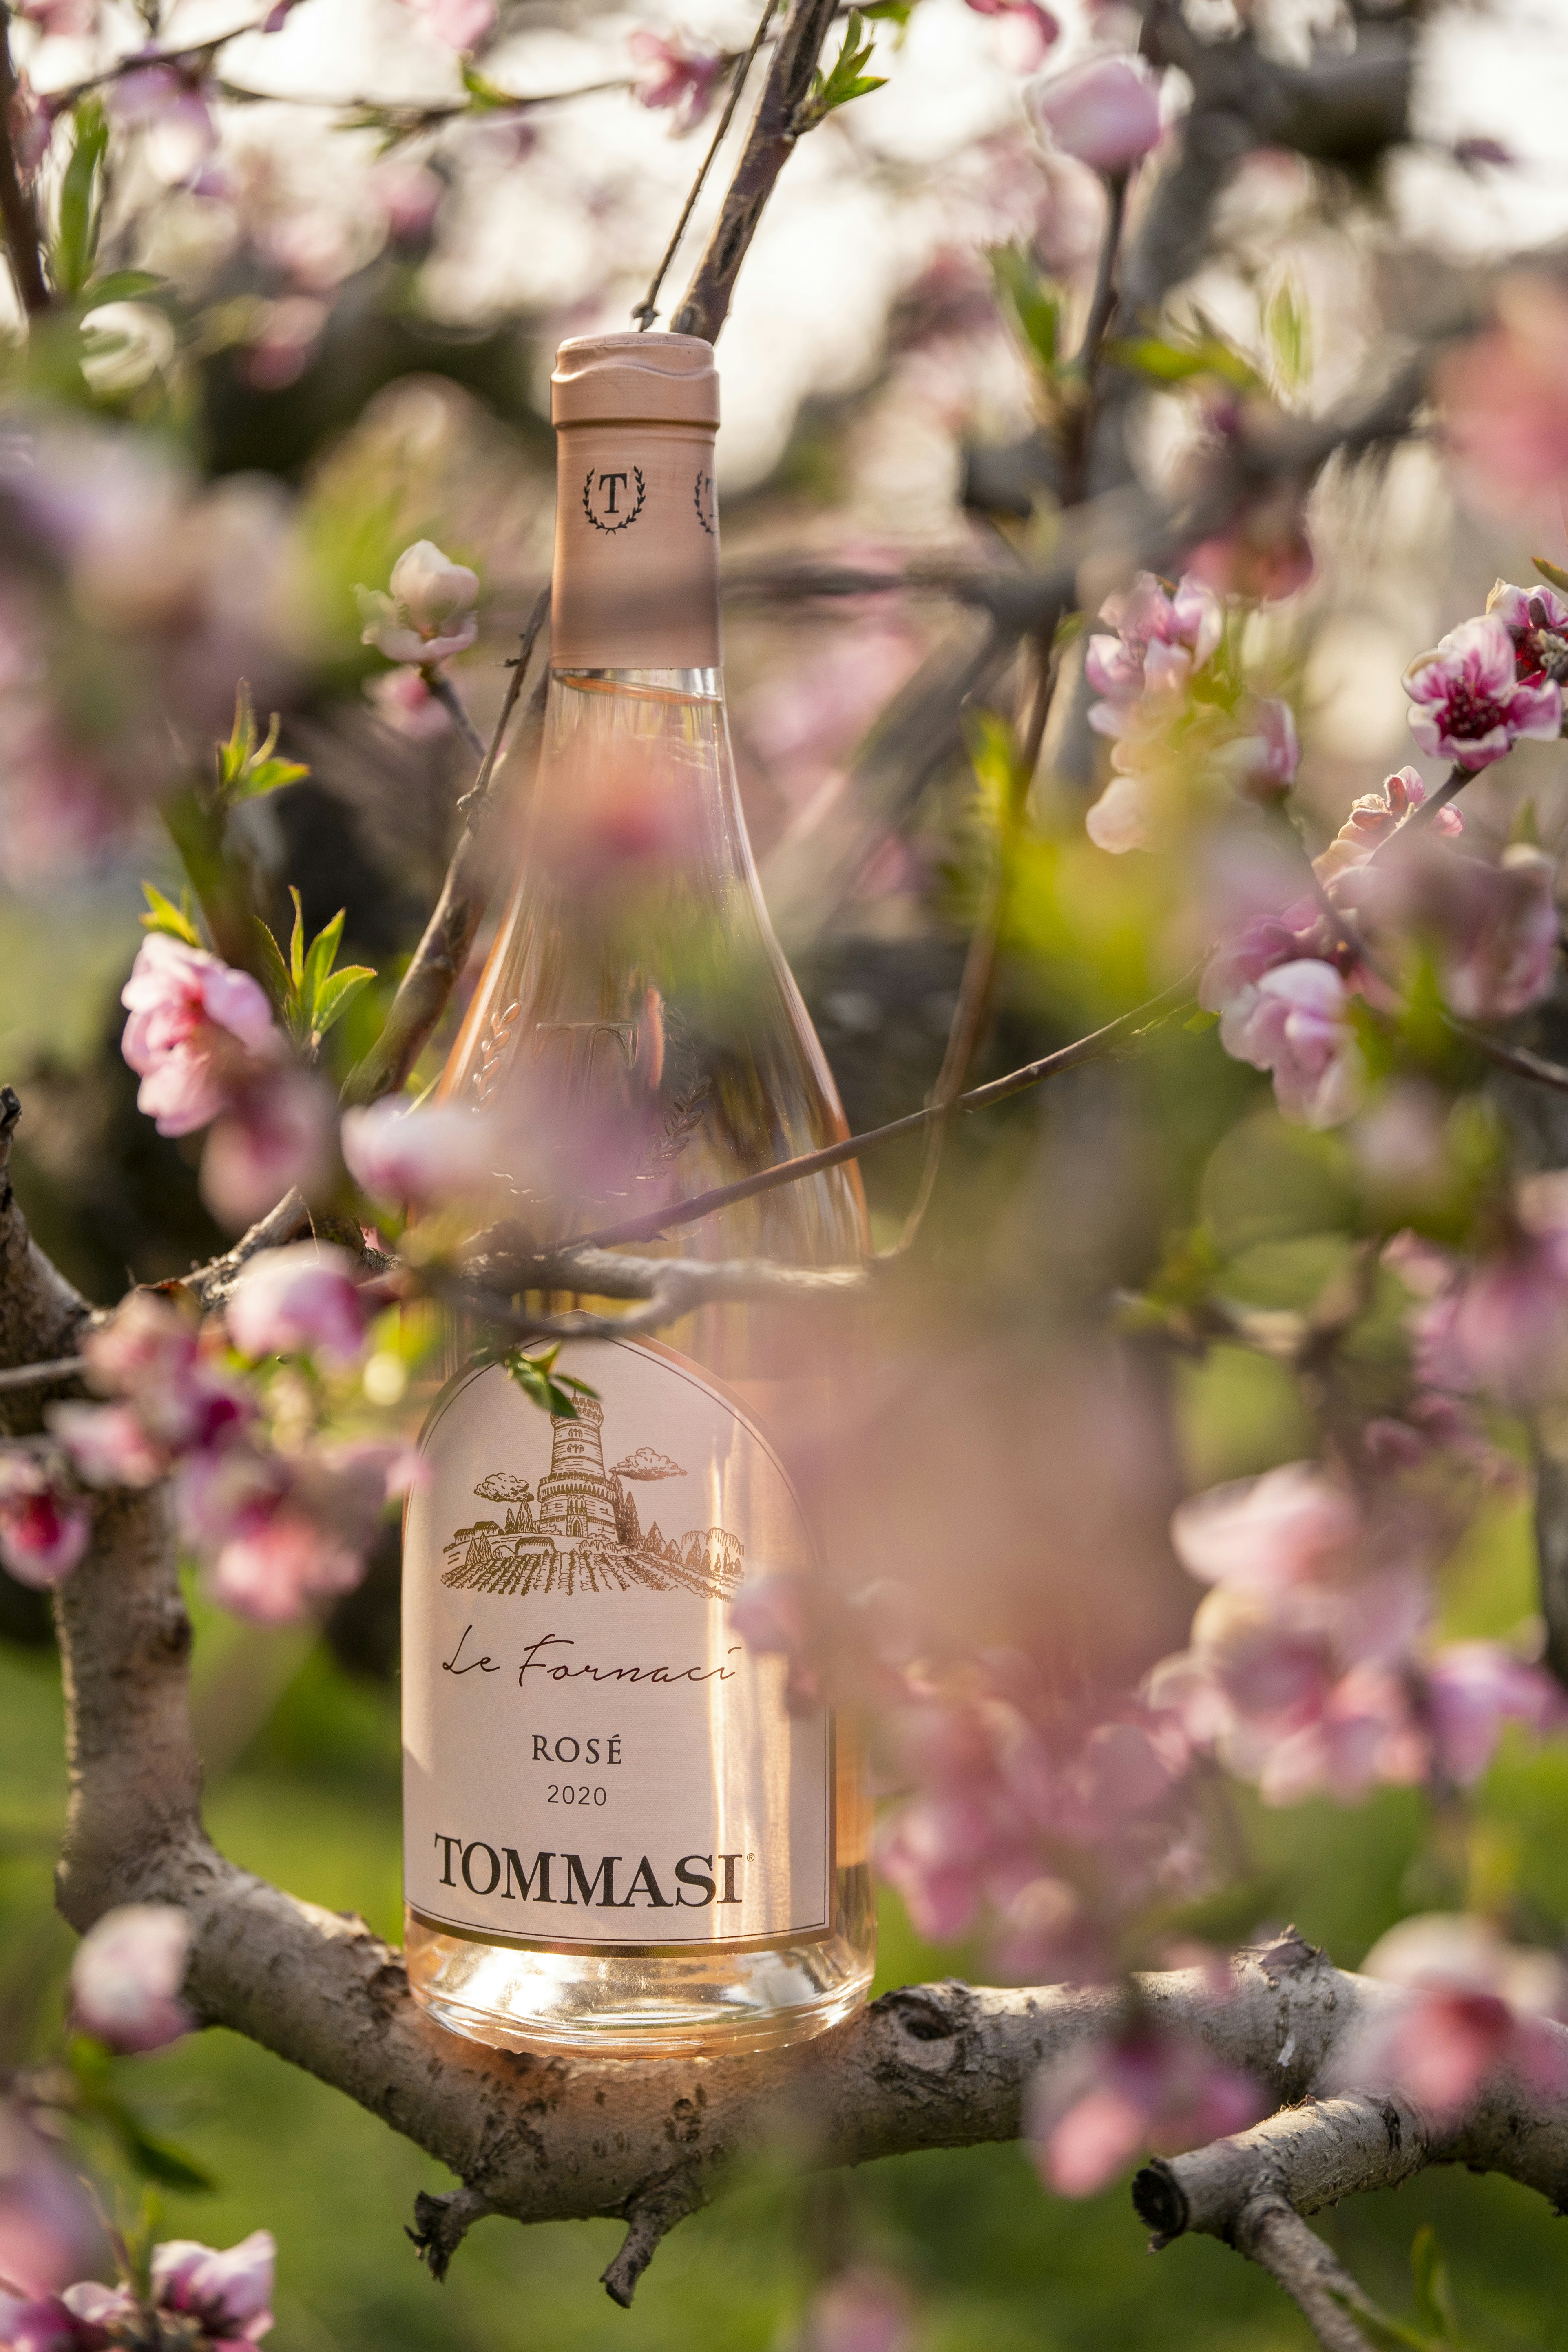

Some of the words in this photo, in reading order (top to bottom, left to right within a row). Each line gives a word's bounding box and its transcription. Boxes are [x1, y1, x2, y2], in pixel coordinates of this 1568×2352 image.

[598, 473, 628, 514] T
[442, 1624, 501, 1675] Le
[518, 1633, 742, 1687] Fornaci
[531, 1734, 623, 1765] ROSÉ
[547, 1784, 607, 1806] 2020
